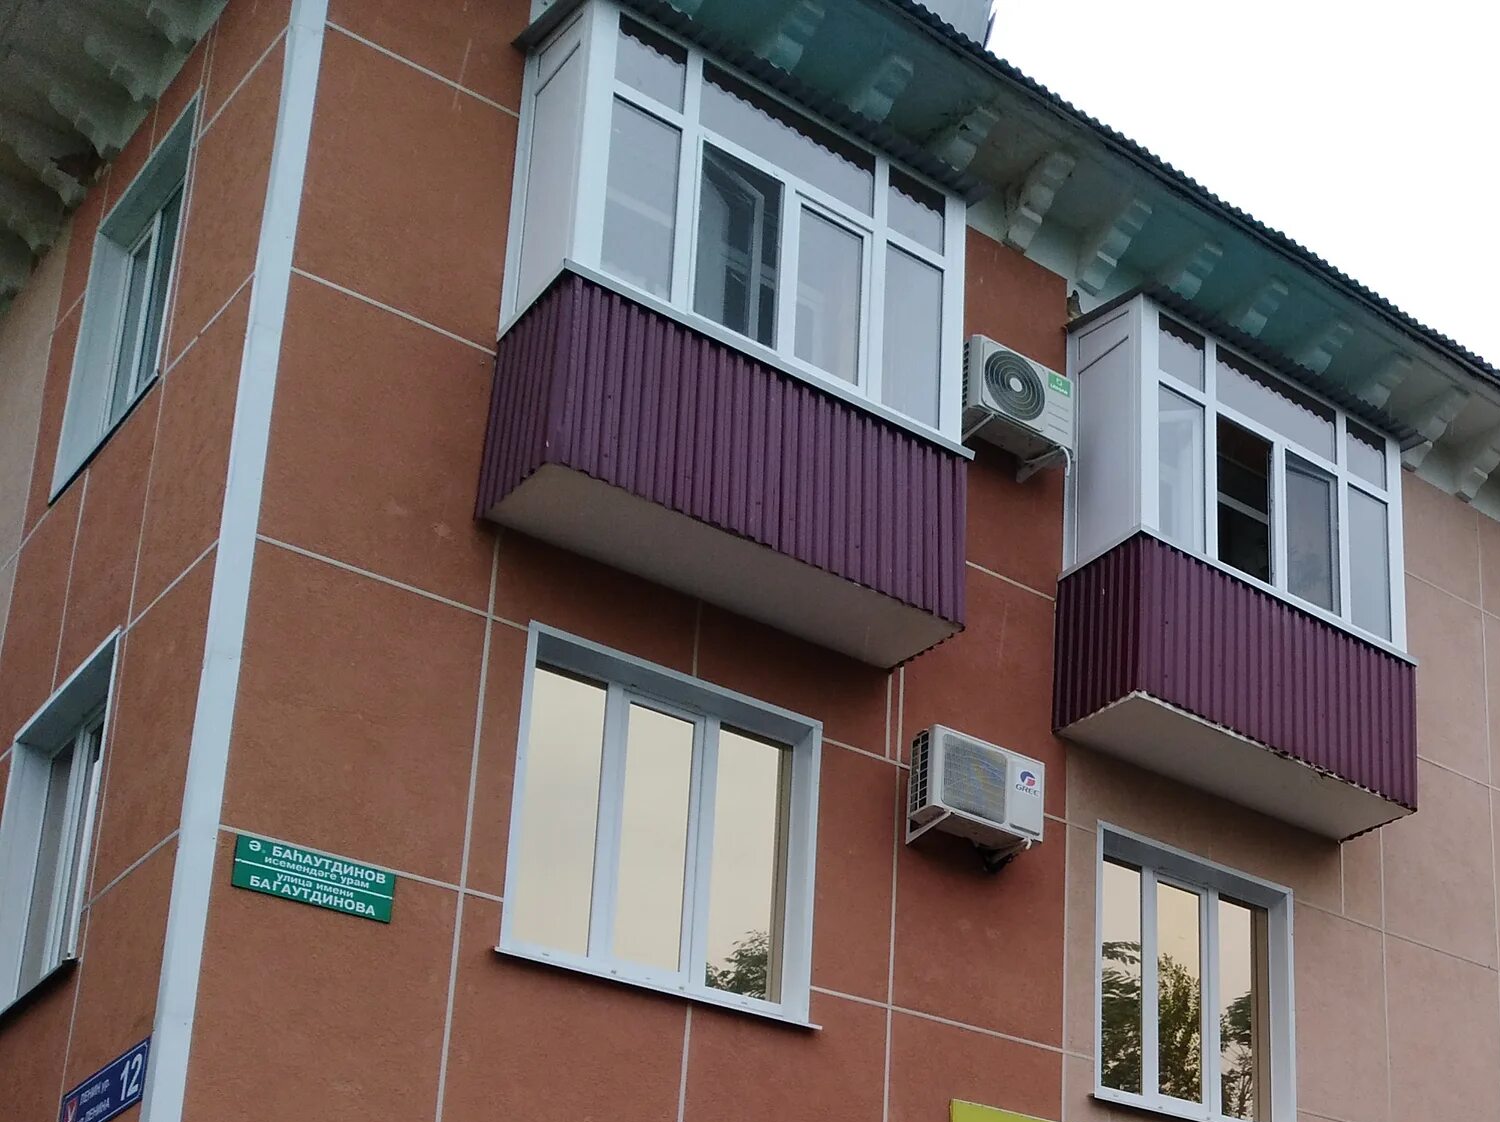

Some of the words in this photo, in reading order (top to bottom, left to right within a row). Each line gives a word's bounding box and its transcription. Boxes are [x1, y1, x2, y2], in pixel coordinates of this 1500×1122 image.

[250, 875, 376, 917] БАГАУТДИНОВА
[276, 873, 312, 889] улица
[316, 883, 354, 899] имени
[340, 875, 370, 889] урам
[120, 1053, 143, 1101] 12
